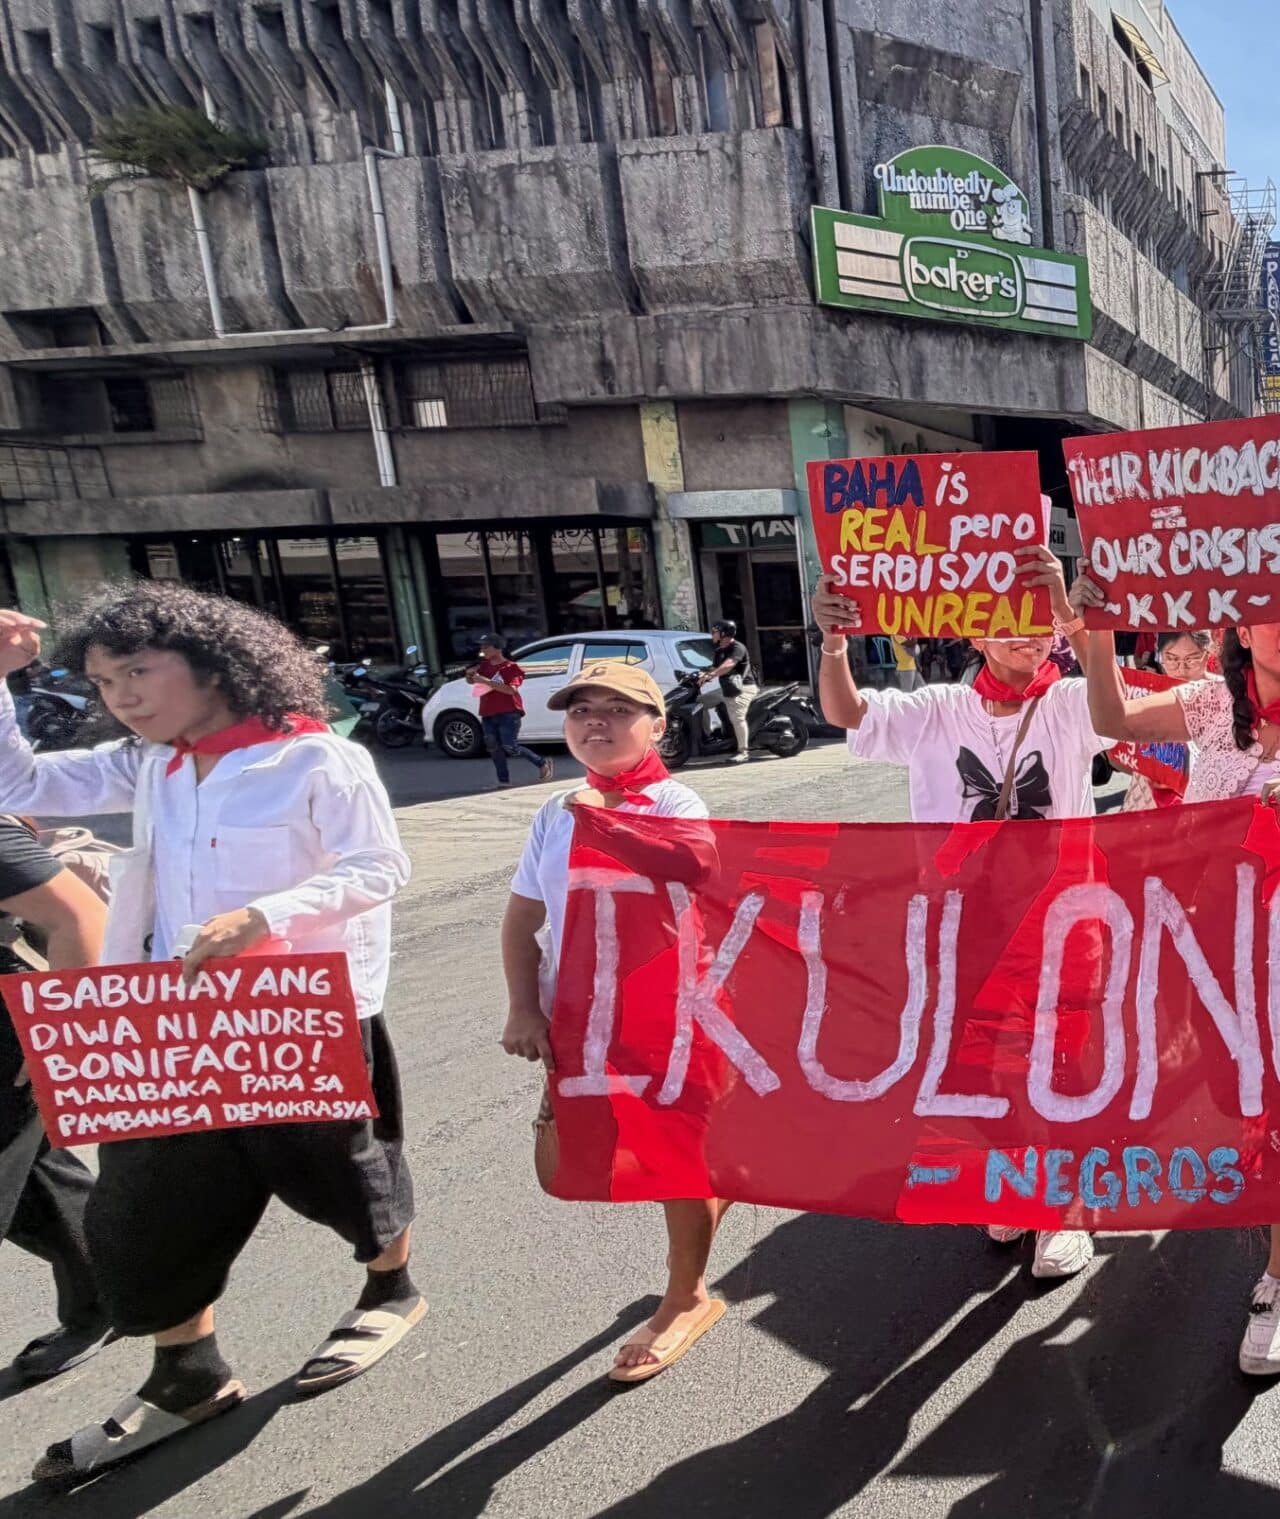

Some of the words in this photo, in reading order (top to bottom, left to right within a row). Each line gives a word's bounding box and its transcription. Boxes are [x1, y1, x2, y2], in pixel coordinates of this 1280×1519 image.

[874, 164, 993, 202] Undoubtedly
[910, 189, 976, 210] numbe
[951, 208, 988, 230] One
[910, 255, 1017, 302] baker's
[824, 459, 925, 514] BAHA
[935, 461, 969, 507] is
[1068, 451, 1149, 507] THEIR
[840, 508, 947, 556] REAL
[949, 512, 1036, 552] pero
[830, 551, 1018, 593] SERBISYO
[1091, 533, 1167, 583] OUR
[877, 590, 1053, 638] UNREAL
[21, 967, 243, 1014] ISABUHAY
[251, 967, 331, 998] ANG
[29, 1016, 142, 1051] DIWA
[157, 1012, 198, 1041] NI
[209, 1008, 345, 1040] ANDRES
[44, 1040, 324, 1082] BONIFACIO!
[54, 1077, 223, 1107] MAKIBAKA
[240, 1073, 305, 1095] PARA
[311, 1074, 345, 1094] SA
[58, 1103, 214, 1138] PAMBANSA
[222, 1100, 373, 1123] DEMOKRASYA
[984, 1145, 1244, 1209] NEGROS
